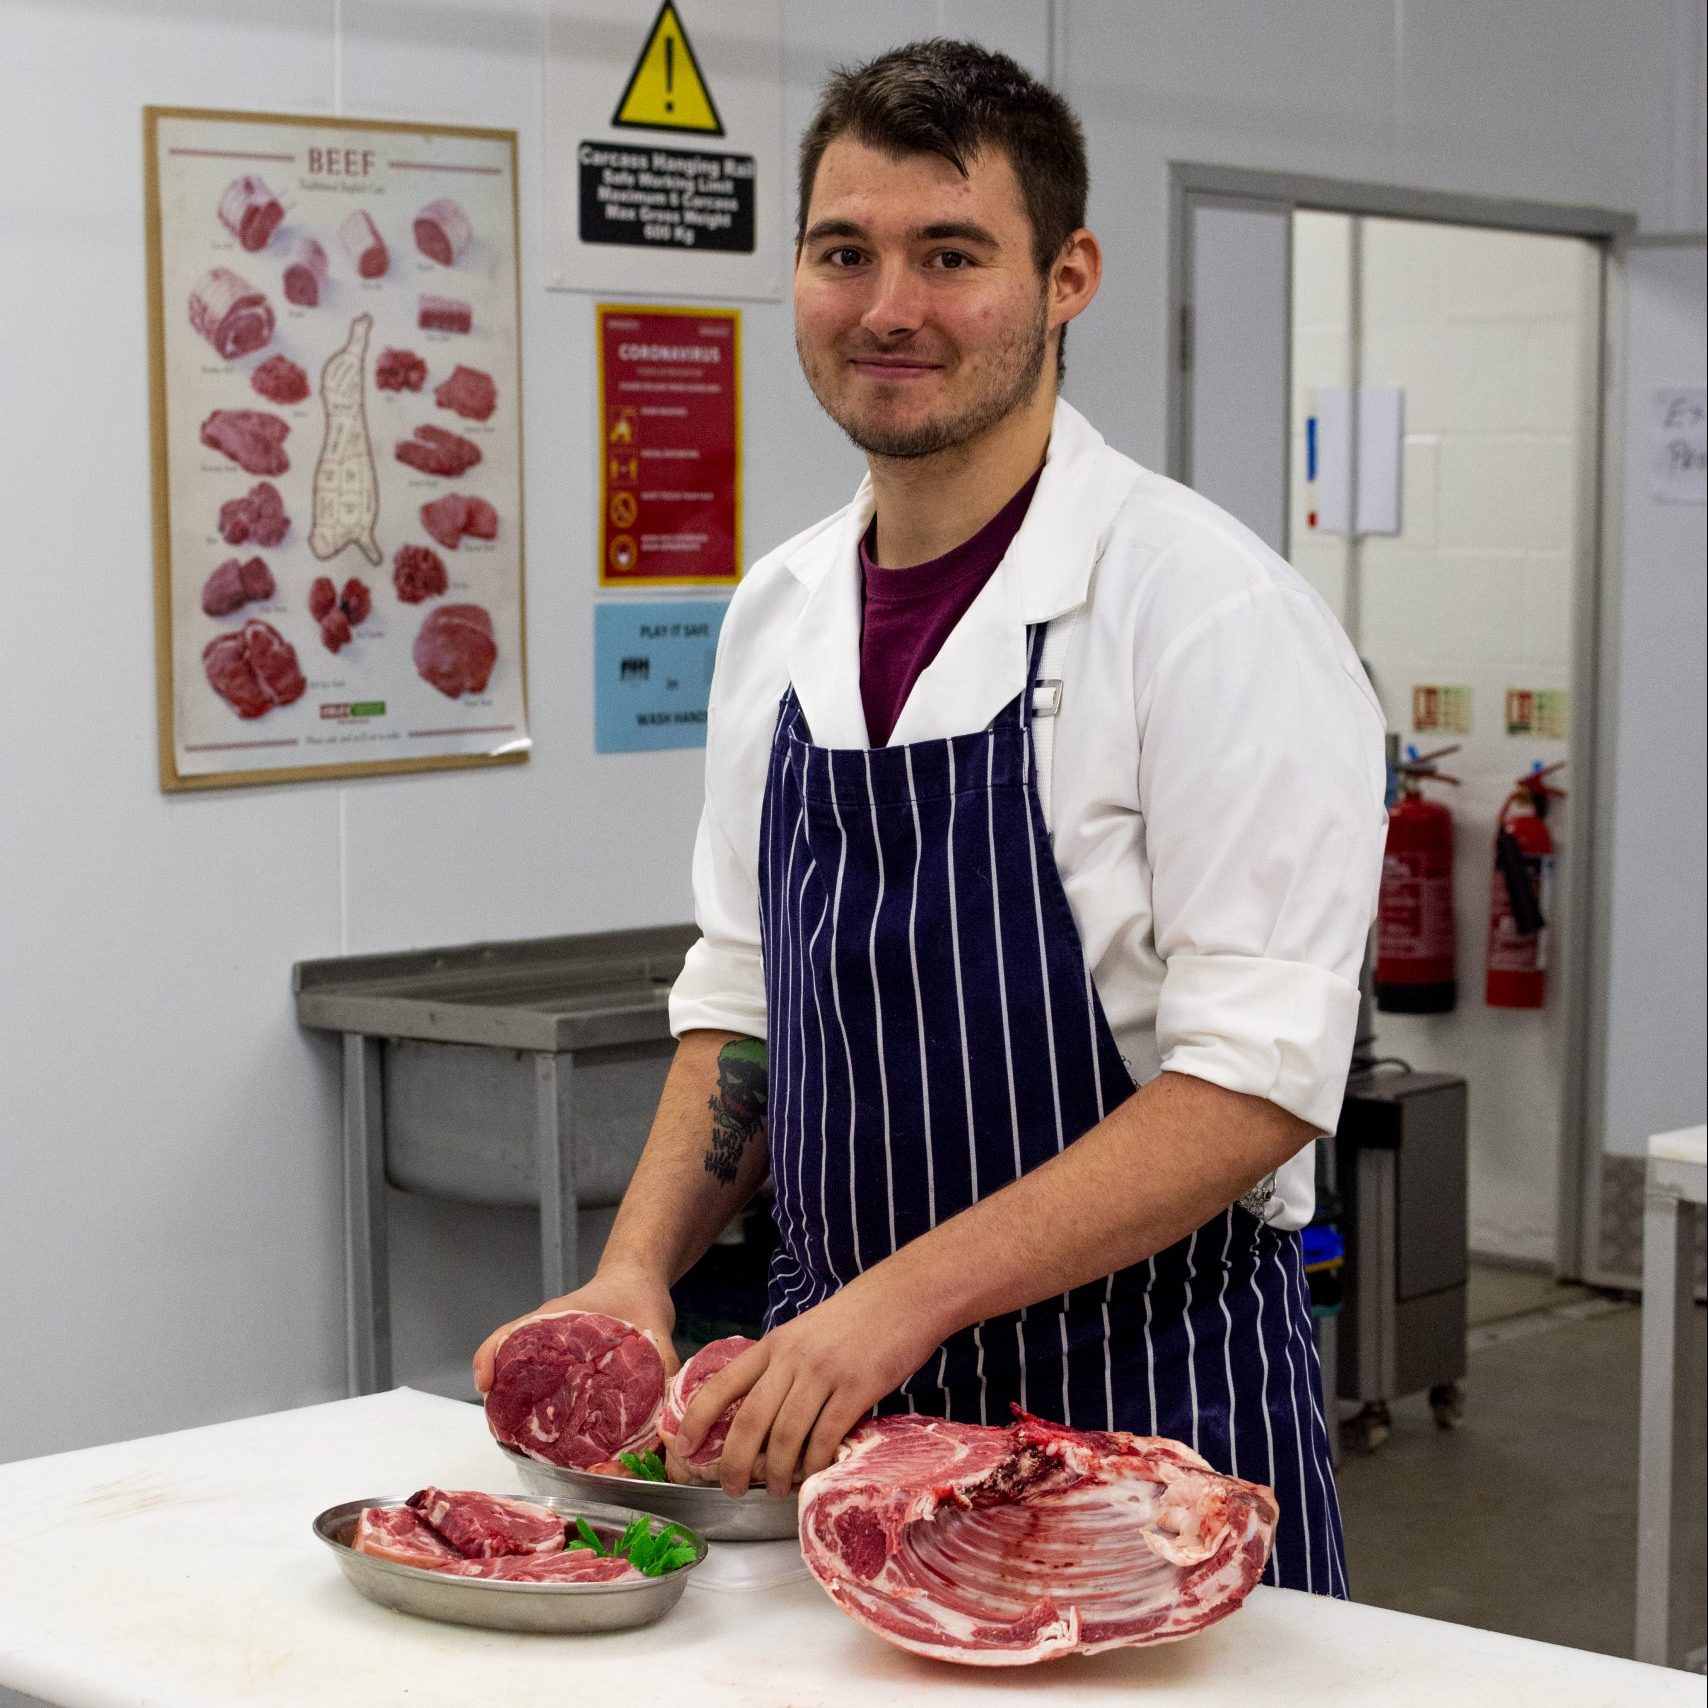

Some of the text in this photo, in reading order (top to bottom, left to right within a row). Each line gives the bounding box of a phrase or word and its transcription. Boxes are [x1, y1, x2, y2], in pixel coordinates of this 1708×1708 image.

[307, 147, 376, 177] BEEF
[581, 146, 648, 168] Carcass
[653, 153, 720, 178] Hanging
[603, 169, 733, 194] Safe Working Limit
[598, 186, 666, 205] Maximum
[682, 193, 738, 211] Carcass
[605, 204, 731, 230] Max Gross Weight
[674, 227, 695, 245] Kg
[618, 343, 721, 362] CORONAVIRUS
[639, 623, 709, 637] PLAY IT SAFE
[637, 712, 671, 727] WASH
